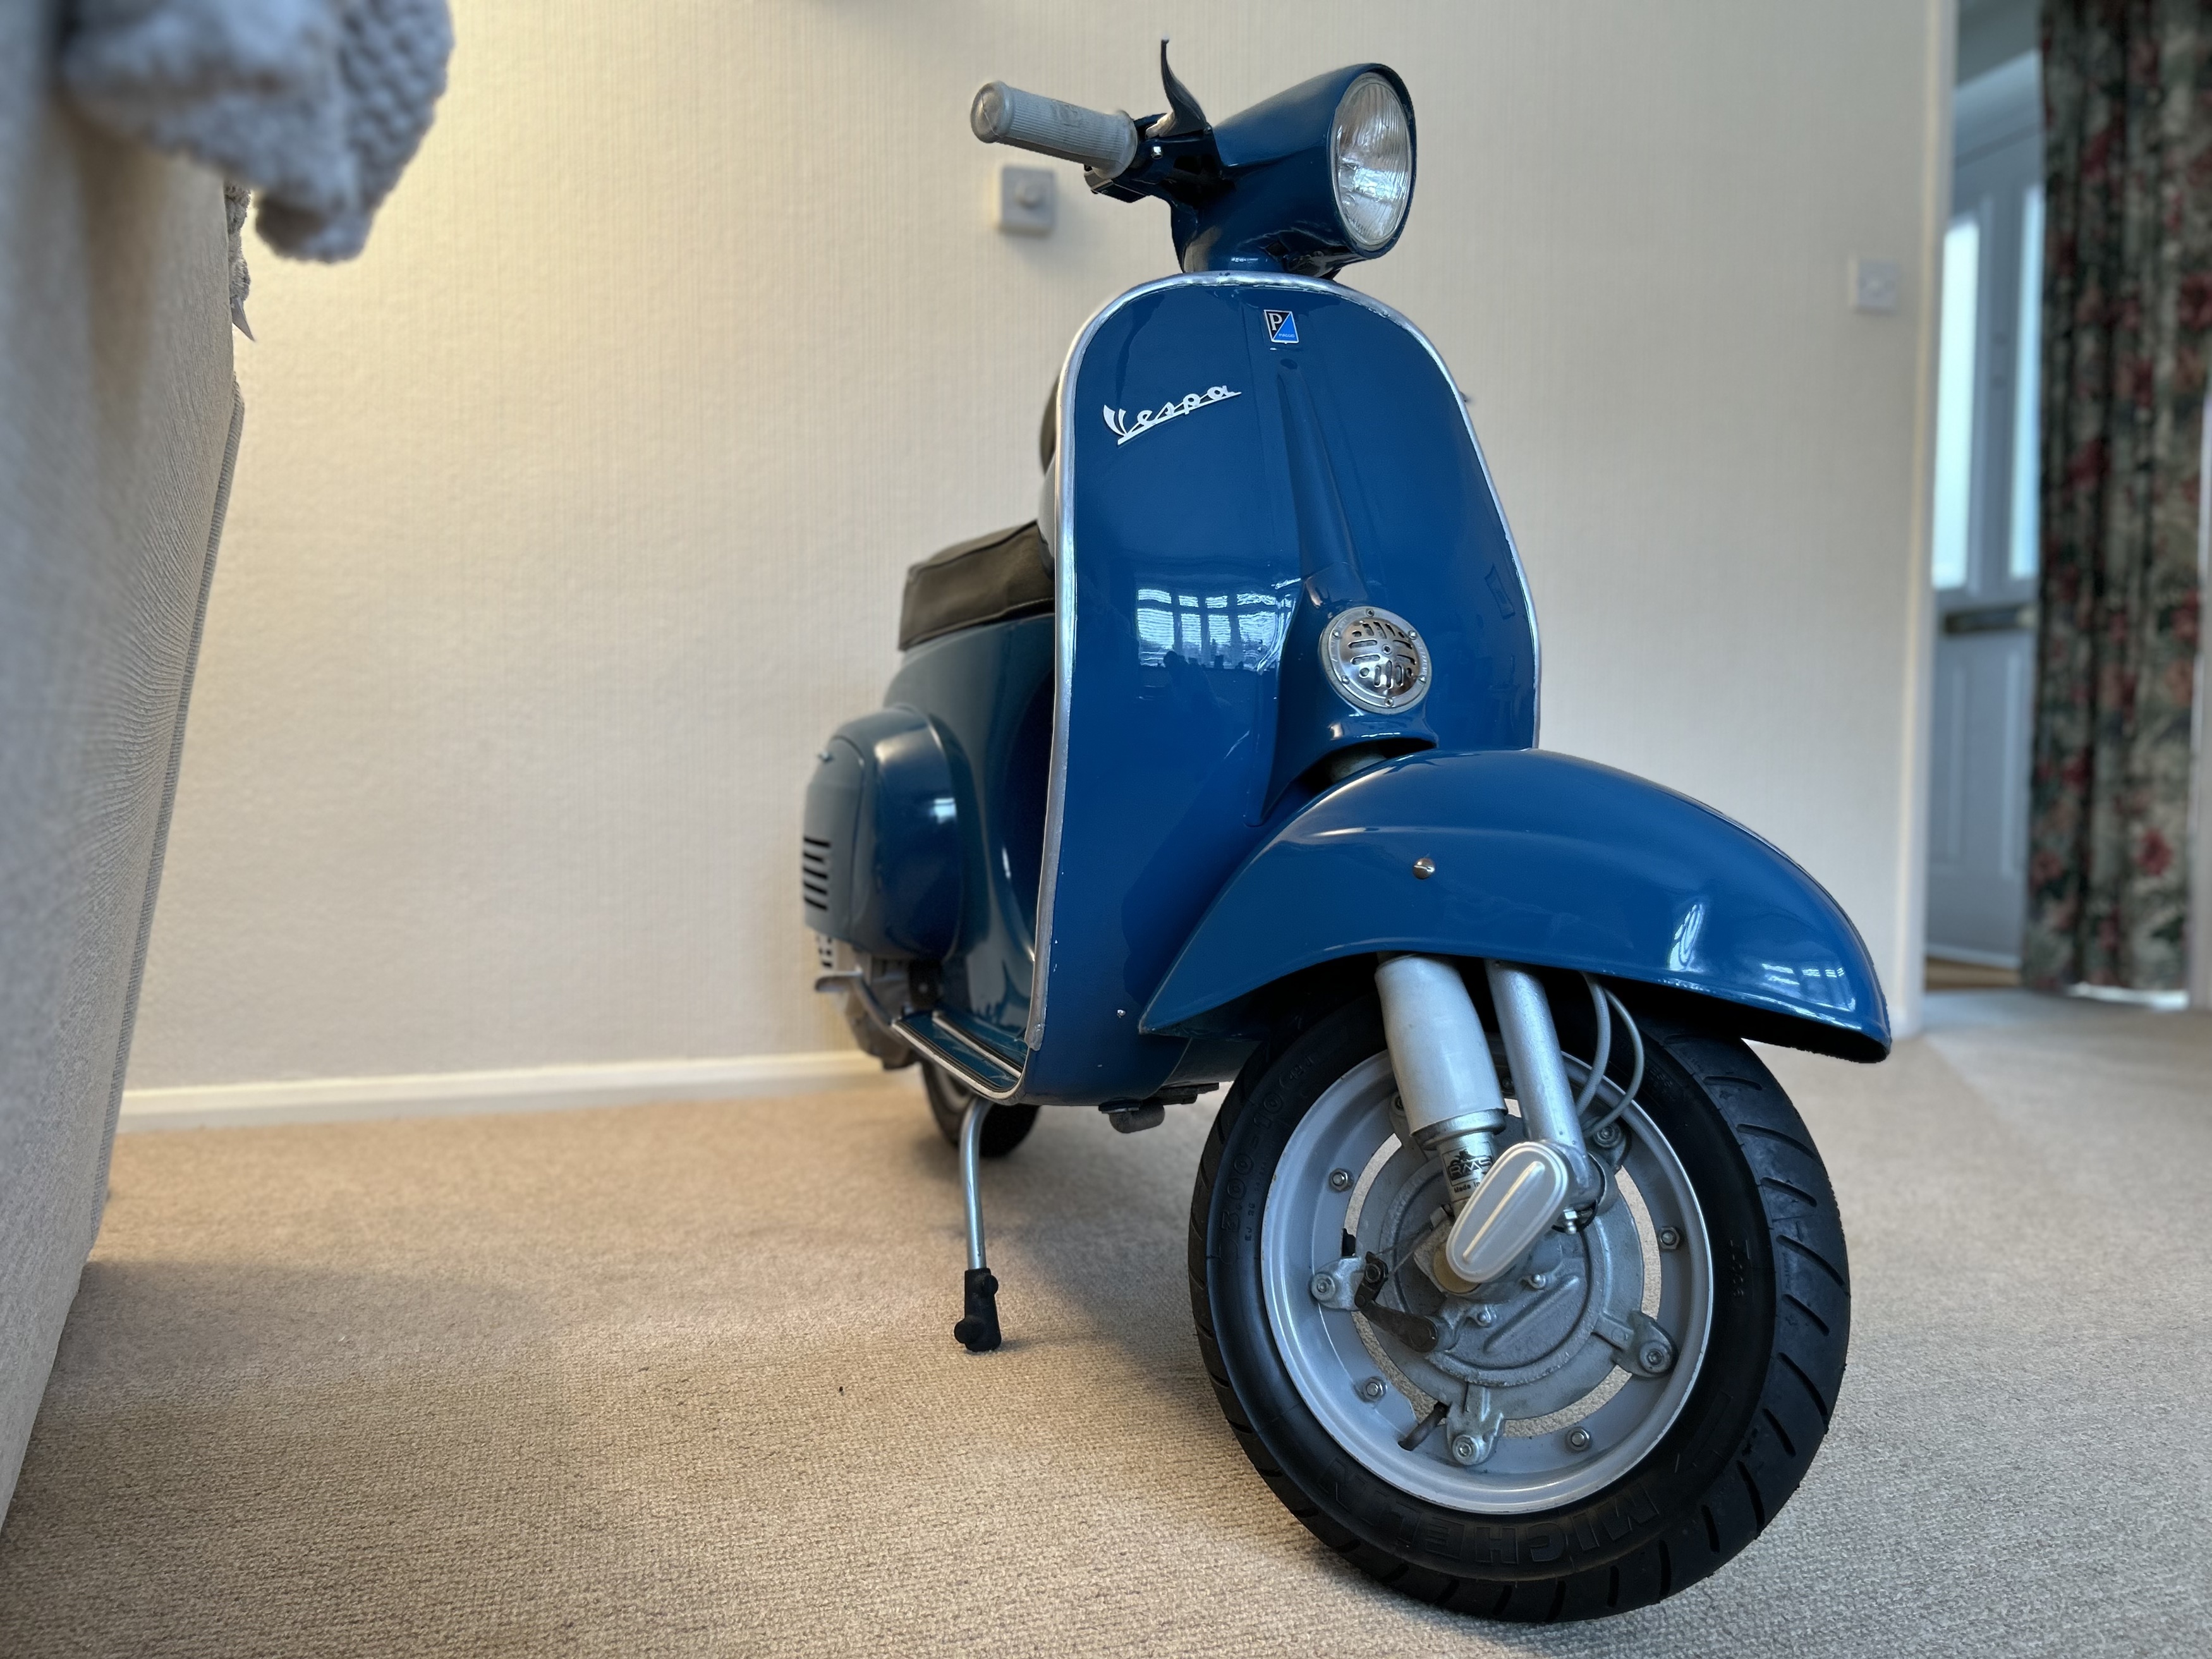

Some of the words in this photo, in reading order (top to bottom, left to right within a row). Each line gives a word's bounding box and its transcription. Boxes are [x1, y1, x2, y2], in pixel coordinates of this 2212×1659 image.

[1268, 313, 1283, 331] P
[1103, 385, 1242, 446] Vespa
[1448, 1155, 1493, 1181] RMS
[1454, 1184, 1472, 1193] Made
[1318, 1457, 1661, 1565] MICHELIN
